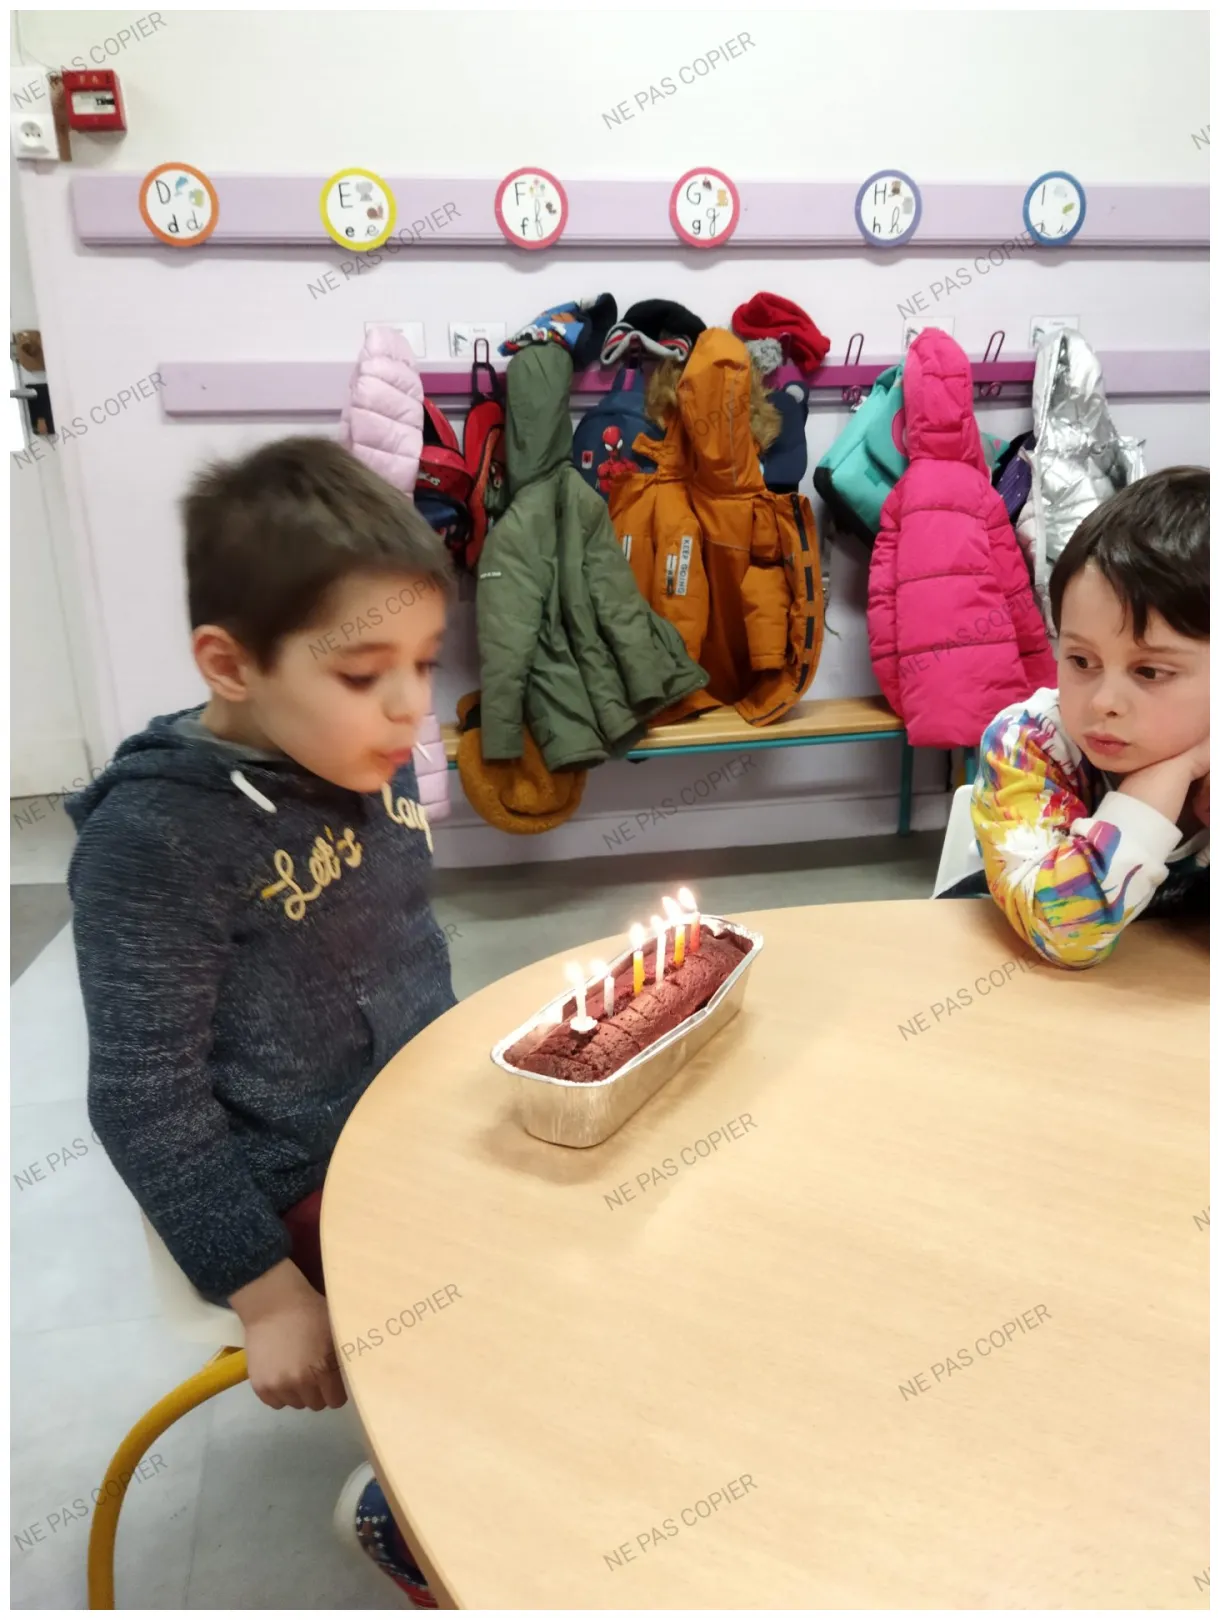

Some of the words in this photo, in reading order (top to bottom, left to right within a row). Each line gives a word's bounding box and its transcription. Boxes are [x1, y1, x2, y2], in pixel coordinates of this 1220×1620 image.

[155, 179, 171, 205] D
[338, 181, 354, 209] E
[514, 181, 527, 207] F
[686, 181, 702, 206] G
[874, 183, 887, 206] H
[167, 213, 180, 234] d
[345, 226, 355, 238] e
[520, 216, 530, 237] f
[692, 219, 702, 236] g
[873, 216, 882, 234] h
[681, 539, 691, 560] KEEP
[677, 564, 688, 594] GOING
[260, 824, 364, 922] Let's
